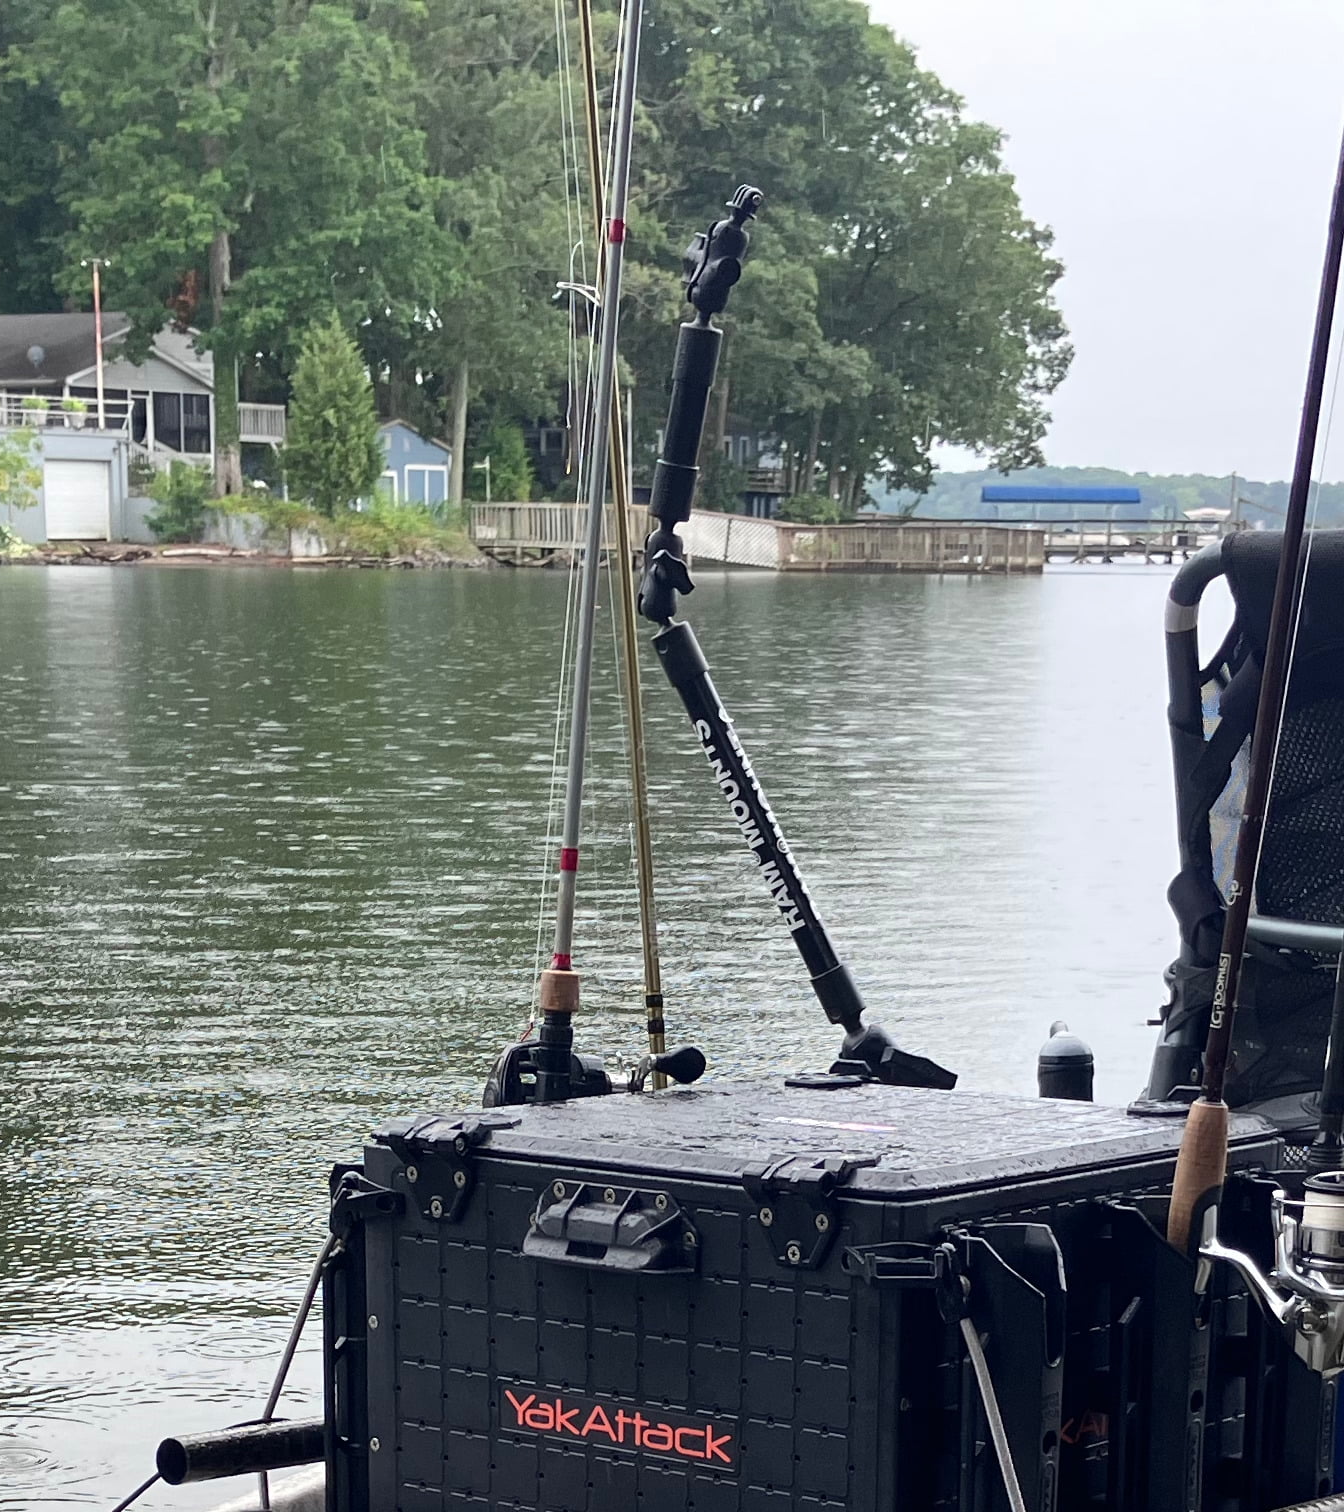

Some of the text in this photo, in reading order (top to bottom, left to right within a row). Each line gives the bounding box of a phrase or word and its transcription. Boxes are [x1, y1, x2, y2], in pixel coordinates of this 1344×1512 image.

[694, 719, 764, 849] MOUNTS
[760, 859, 805, 932] RAM
[504, 1389, 732, 1464] YakAttack
